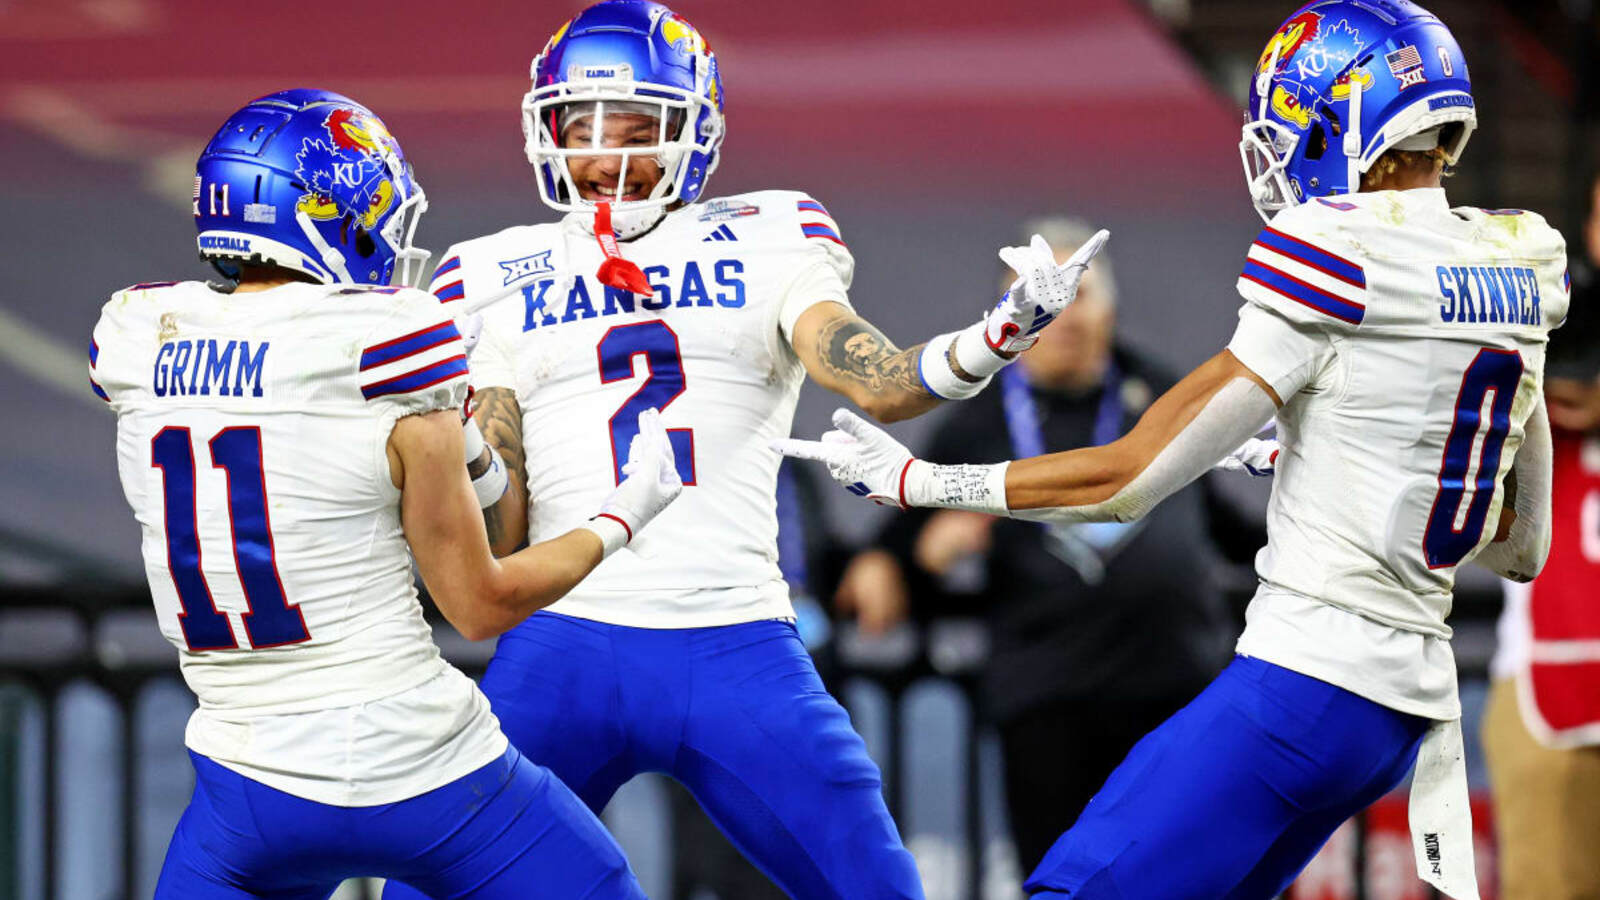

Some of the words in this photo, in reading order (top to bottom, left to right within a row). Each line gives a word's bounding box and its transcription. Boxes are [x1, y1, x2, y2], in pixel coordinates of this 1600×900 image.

[1296, 47, 1328, 81] KU
[1437, 46, 1454, 77] 0
[209, 183, 230, 216] 11
[332, 162, 364, 187] KU
[522, 259, 746, 332] KANSAS
[1435, 265, 1541, 326] SKINNER
[154, 339, 269, 397] GRIMM
[597, 319, 697, 487] 2
[1422, 347, 1524, 569] 0
[152, 425, 312, 650] 11
